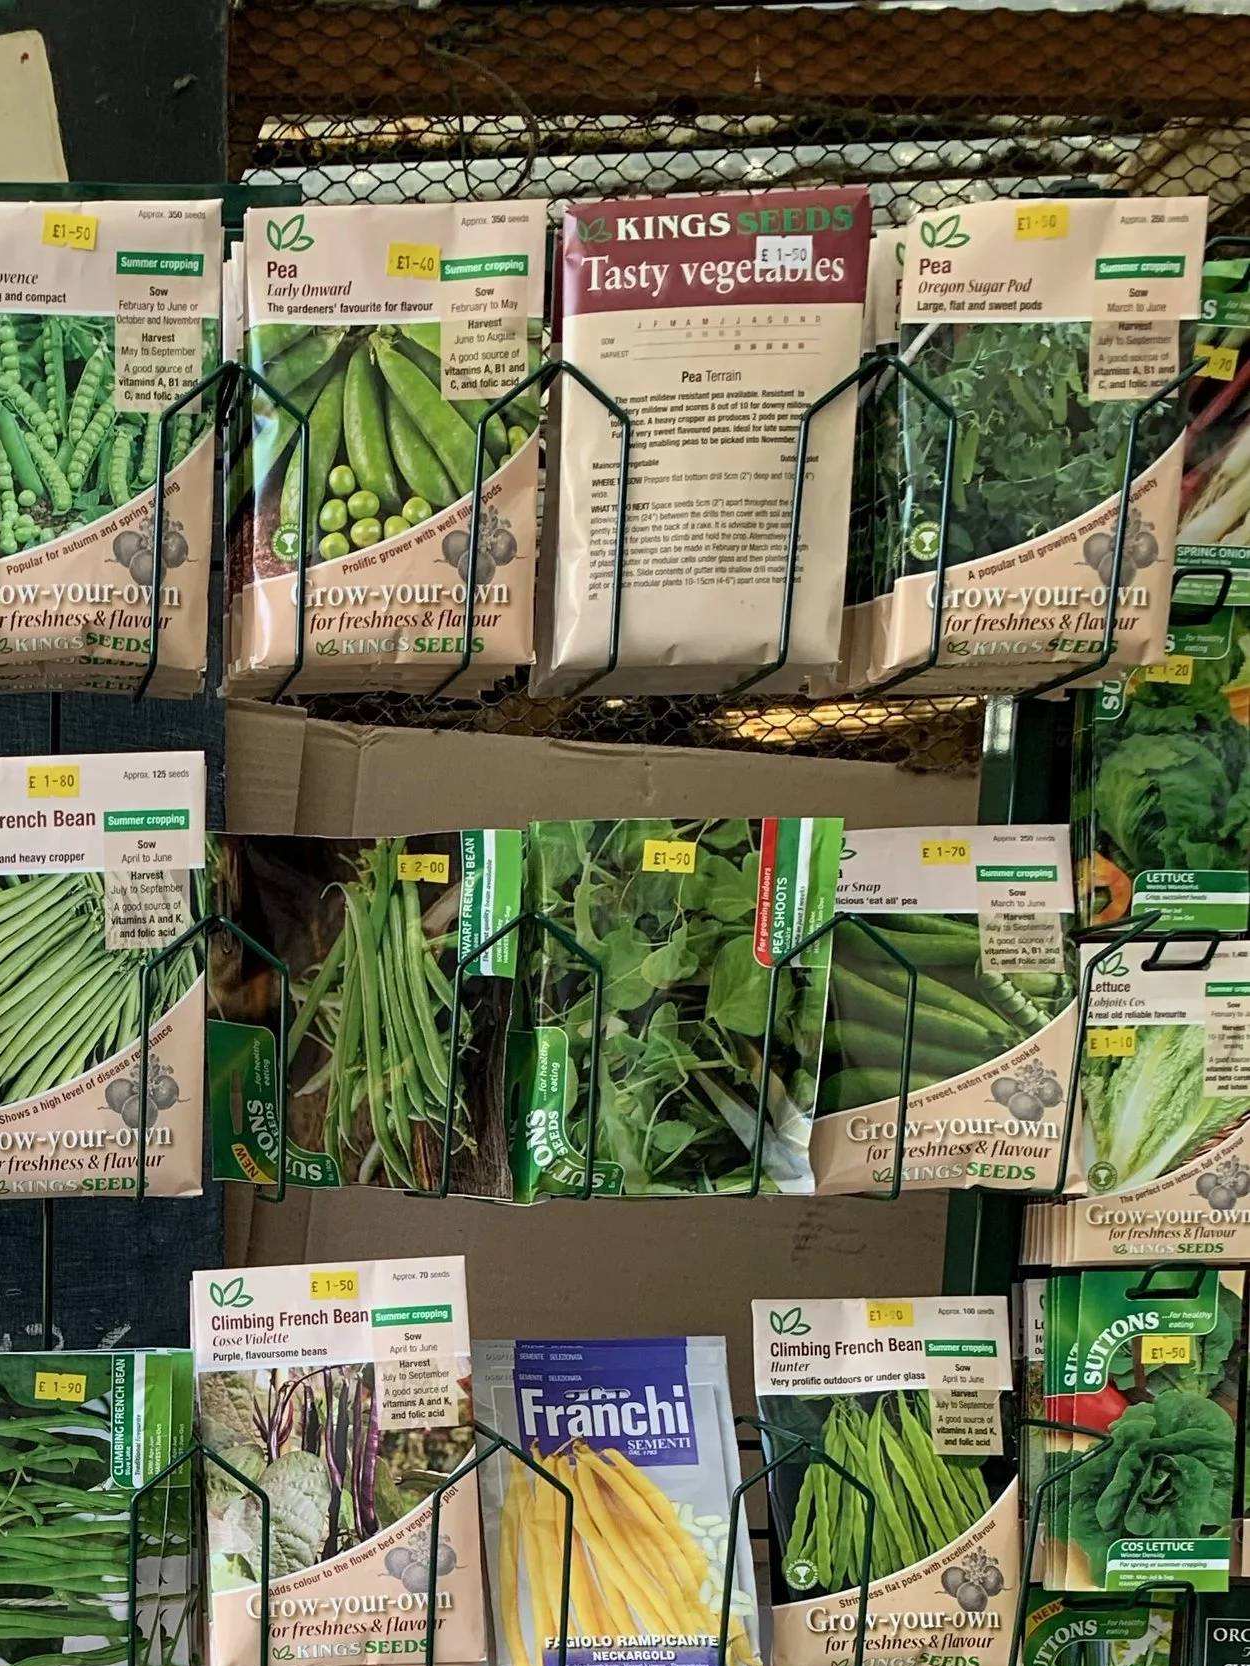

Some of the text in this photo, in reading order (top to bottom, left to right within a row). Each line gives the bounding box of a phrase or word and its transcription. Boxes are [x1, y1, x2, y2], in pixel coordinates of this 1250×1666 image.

[616, 205, 854, 241] KINGS SEEDS
[52, 224, 91, 240] £1-50
[120, 257, 199, 271] Summer cropping
[267, 262, 298, 278] Pea
[396, 256, 434, 271] £1-40
[919, 258, 951, 276] Pea
[581, 255, 669, 297] Tasty
[149, 286, 168, 296] Sow
[267, 281, 352, 298] Early Onward
[918, 278, 1032, 295] Oregon Sugar Pod
[5, 291, 22, 301] and
[26, 292, 66, 303] compact
[267, 301, 433, 314] The gardeners' favourite for flavour
[142, 333, 175, 343] Harvest
[682, 370, 742, 383] Pea Terrain
[1176, 546, 1216, 558] SPRING
[44, 775, 74, 788] 1-80
[53, 810, 96, 827] Bean
[0, 854, 16, 864] and
[19, 854, 46, 864] heavy
[49, 852, 86, 864] cropper
[653, 852, 691, 866] £1-90
[937, 847, 966, 858] 1-70
[415, 861, 445, 874] 2-00
[1146, 872, 1195, 883] LETTUCE
[852, 882, 881, 894] Snap
[761, 867, 772, 938] growing indoors
[776, 876, 787, 921] SHOOTS
[1130, 998, 1146, 1007] Cos
[326, 1280, 354, 1291] 1-50
[211, 1308, 369, 1332] Climbing French Bean
[212, 1333, 289, 1348] Cosse Violette
[213, 1347, 327, 1362] Purple, flavoursome beans
[1083, 1311, 1160, 1385] SUTTONS
[1151, 1346, 1186, 1359] £1-50
[771, 1361, 810, 1373] Hunter
[113, 1358, 126, 1476] CLIMBING FRENCH BEAN
[520, 1384, 691, 1438] Franchi
[627, 1437, 691, 1451] SEMENTI
[1121, 1542, 1195, 1552] COS LETTUCE
[1031, 1601, 1063, 1625] NEW
[616, 1635, 719, 1648] RAMPICANTE
[592, 1650, 676, 1662] NECKARGOLD
